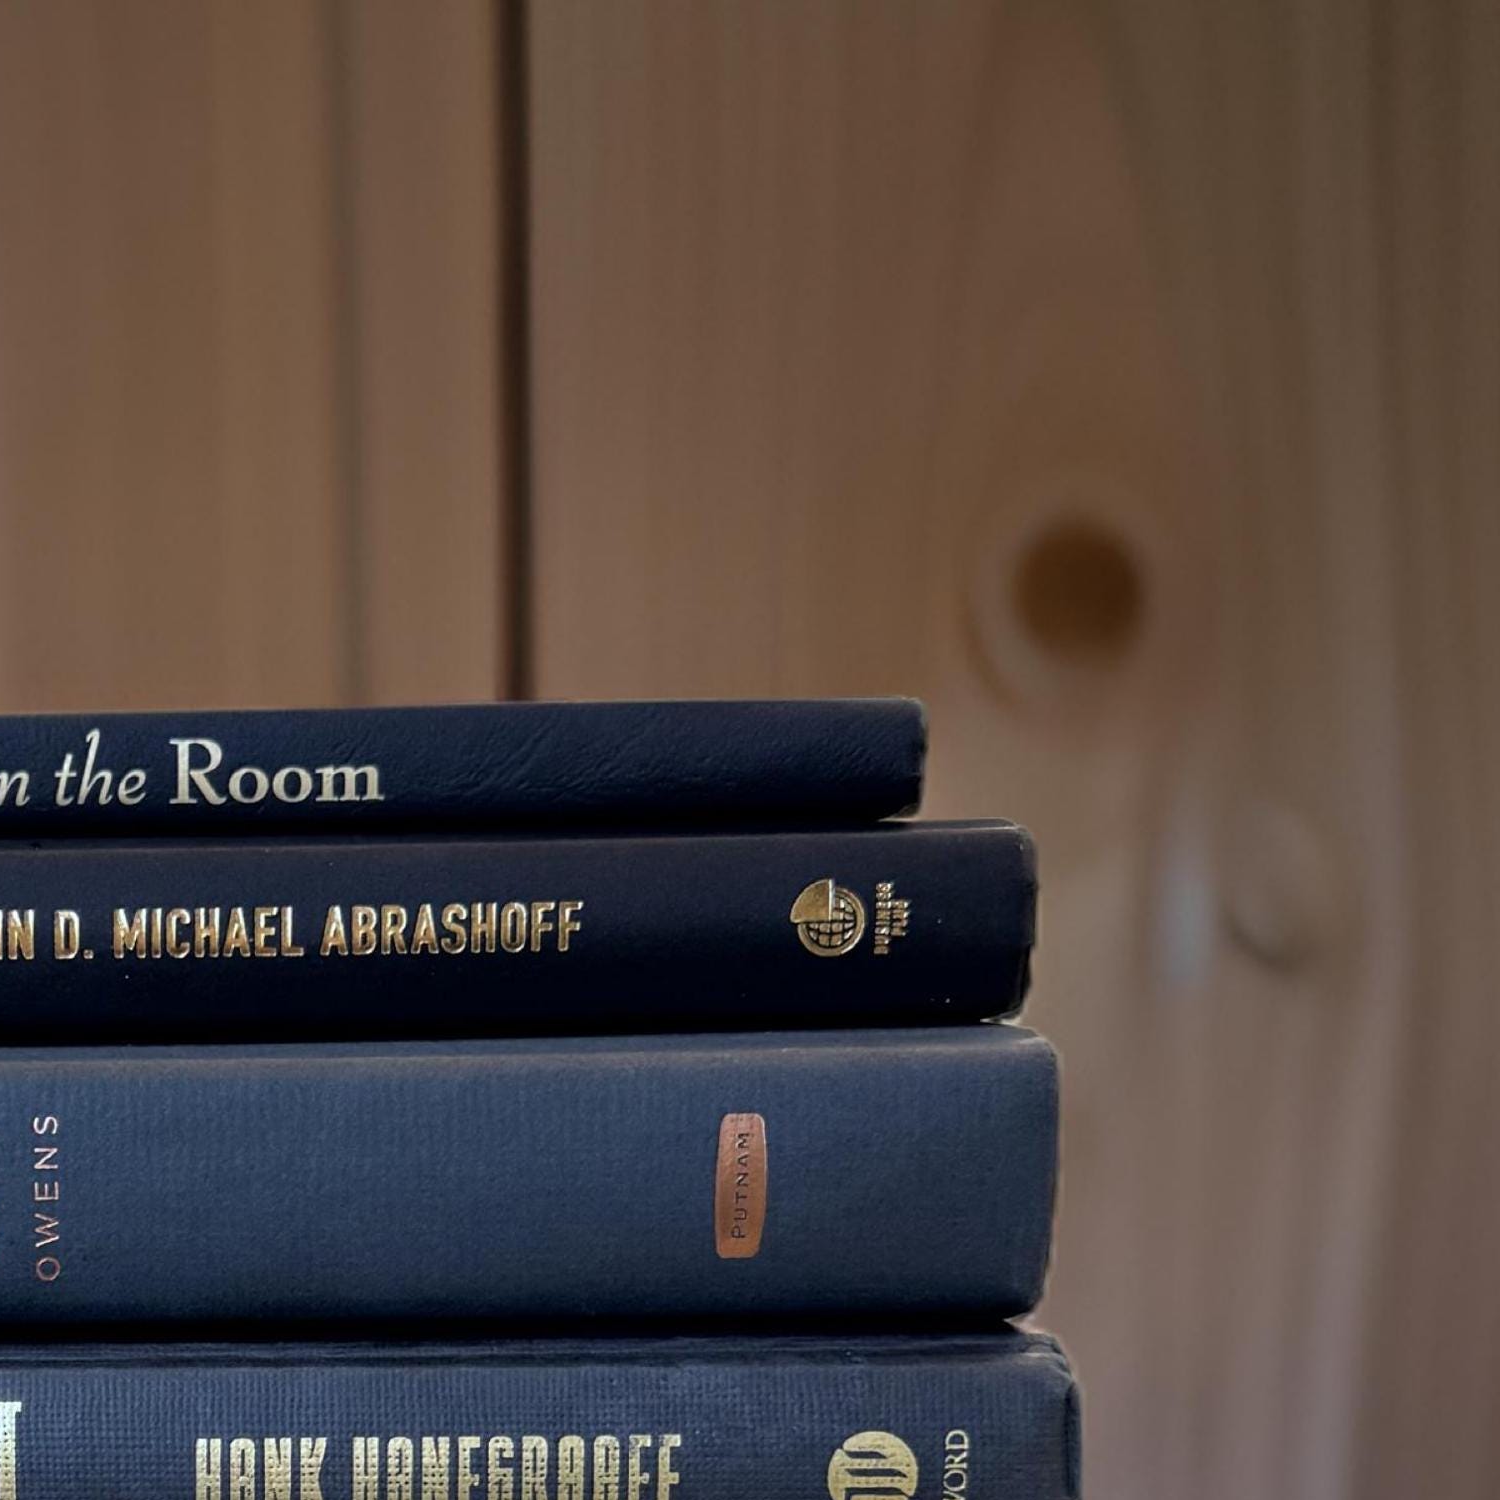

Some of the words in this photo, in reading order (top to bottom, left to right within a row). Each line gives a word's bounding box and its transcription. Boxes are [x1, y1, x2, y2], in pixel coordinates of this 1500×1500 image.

[53, 728, 148, 805] the
[168, 737, 385, 804] Room
[52, 907, 94, 960] D.
[111, 904, 304, 959] MICHAEL
[320, 900, 583, 955] ABRASHOFF
[33, 1115, 60, 1282] OWENS
[731, 1132, 749, 1239] PUTNAM
